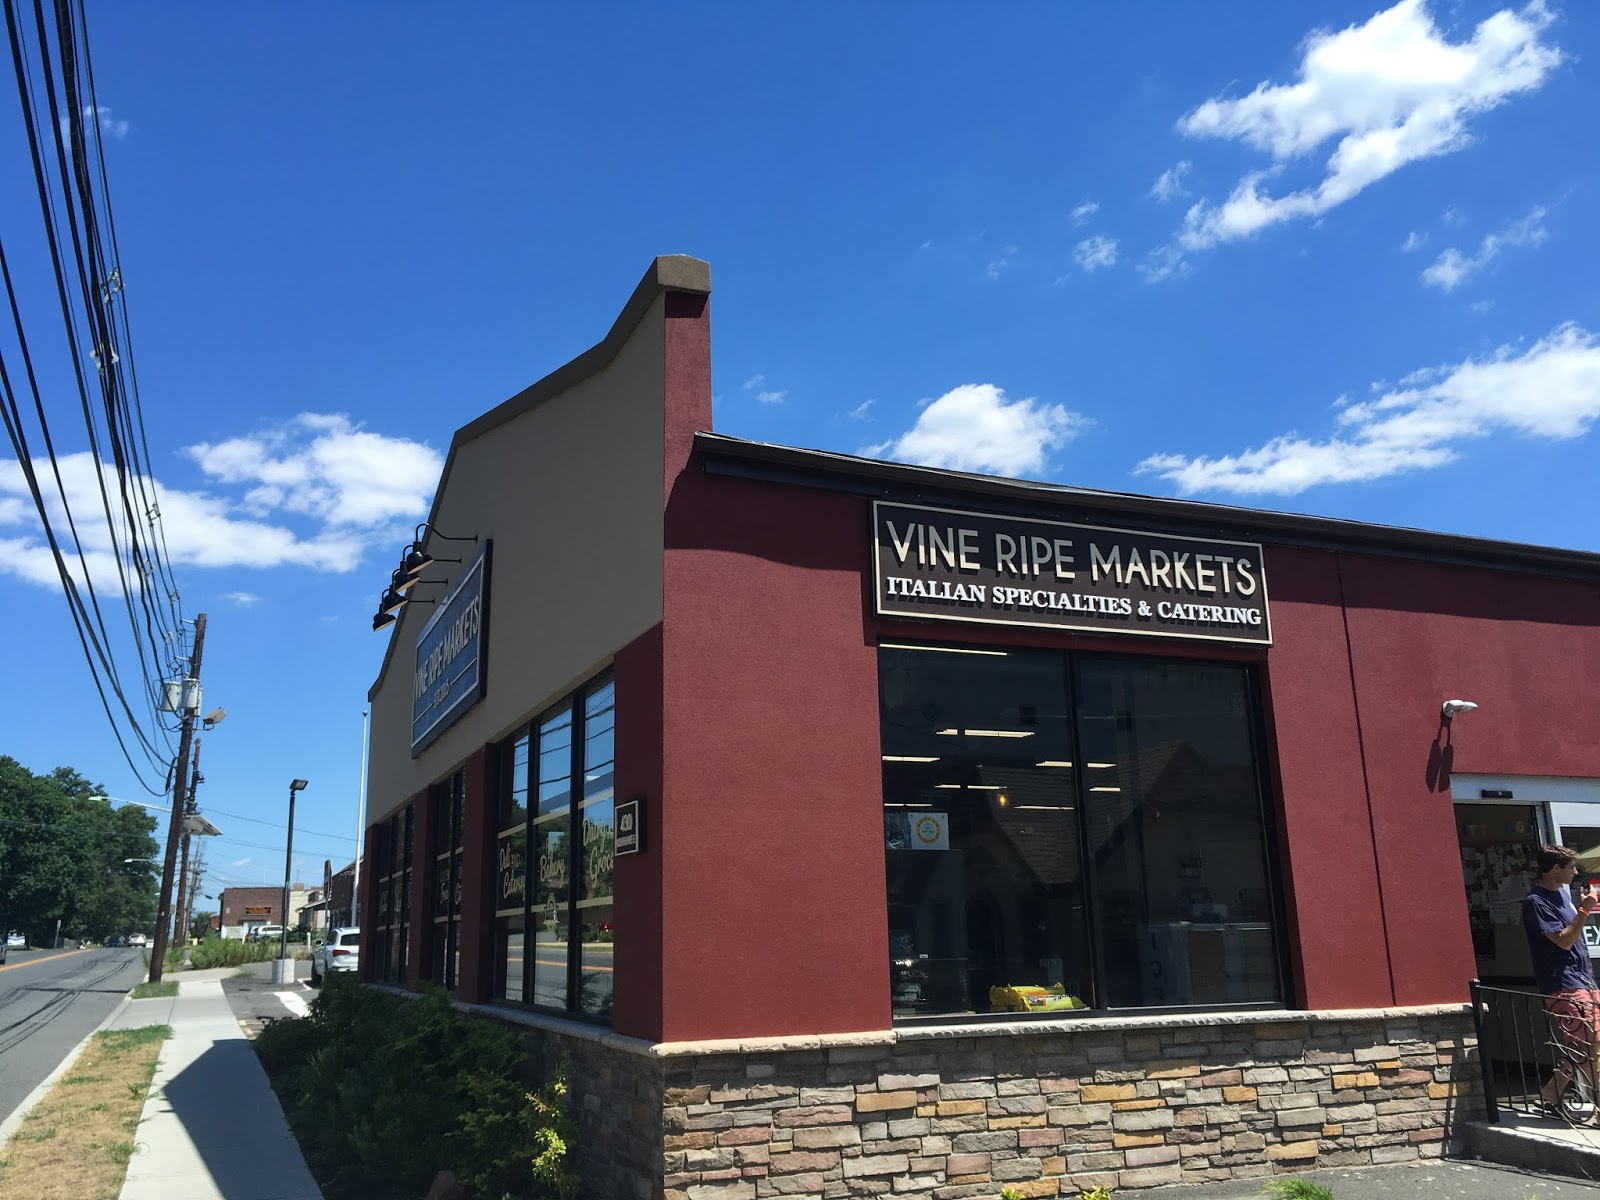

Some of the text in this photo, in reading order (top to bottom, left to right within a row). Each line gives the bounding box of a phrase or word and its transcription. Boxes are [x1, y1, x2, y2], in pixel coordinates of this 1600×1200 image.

[886, 520, 1256, 597] VINE RIPE MARKETS
[886, 576, 1263, 626] ITALIAN SPECIALTIES & CATERING
[428, 640, 444, 688] RIPE
[442, 594, 480, 669] MARKETS
[540, 847, 566, 889] Bakery
